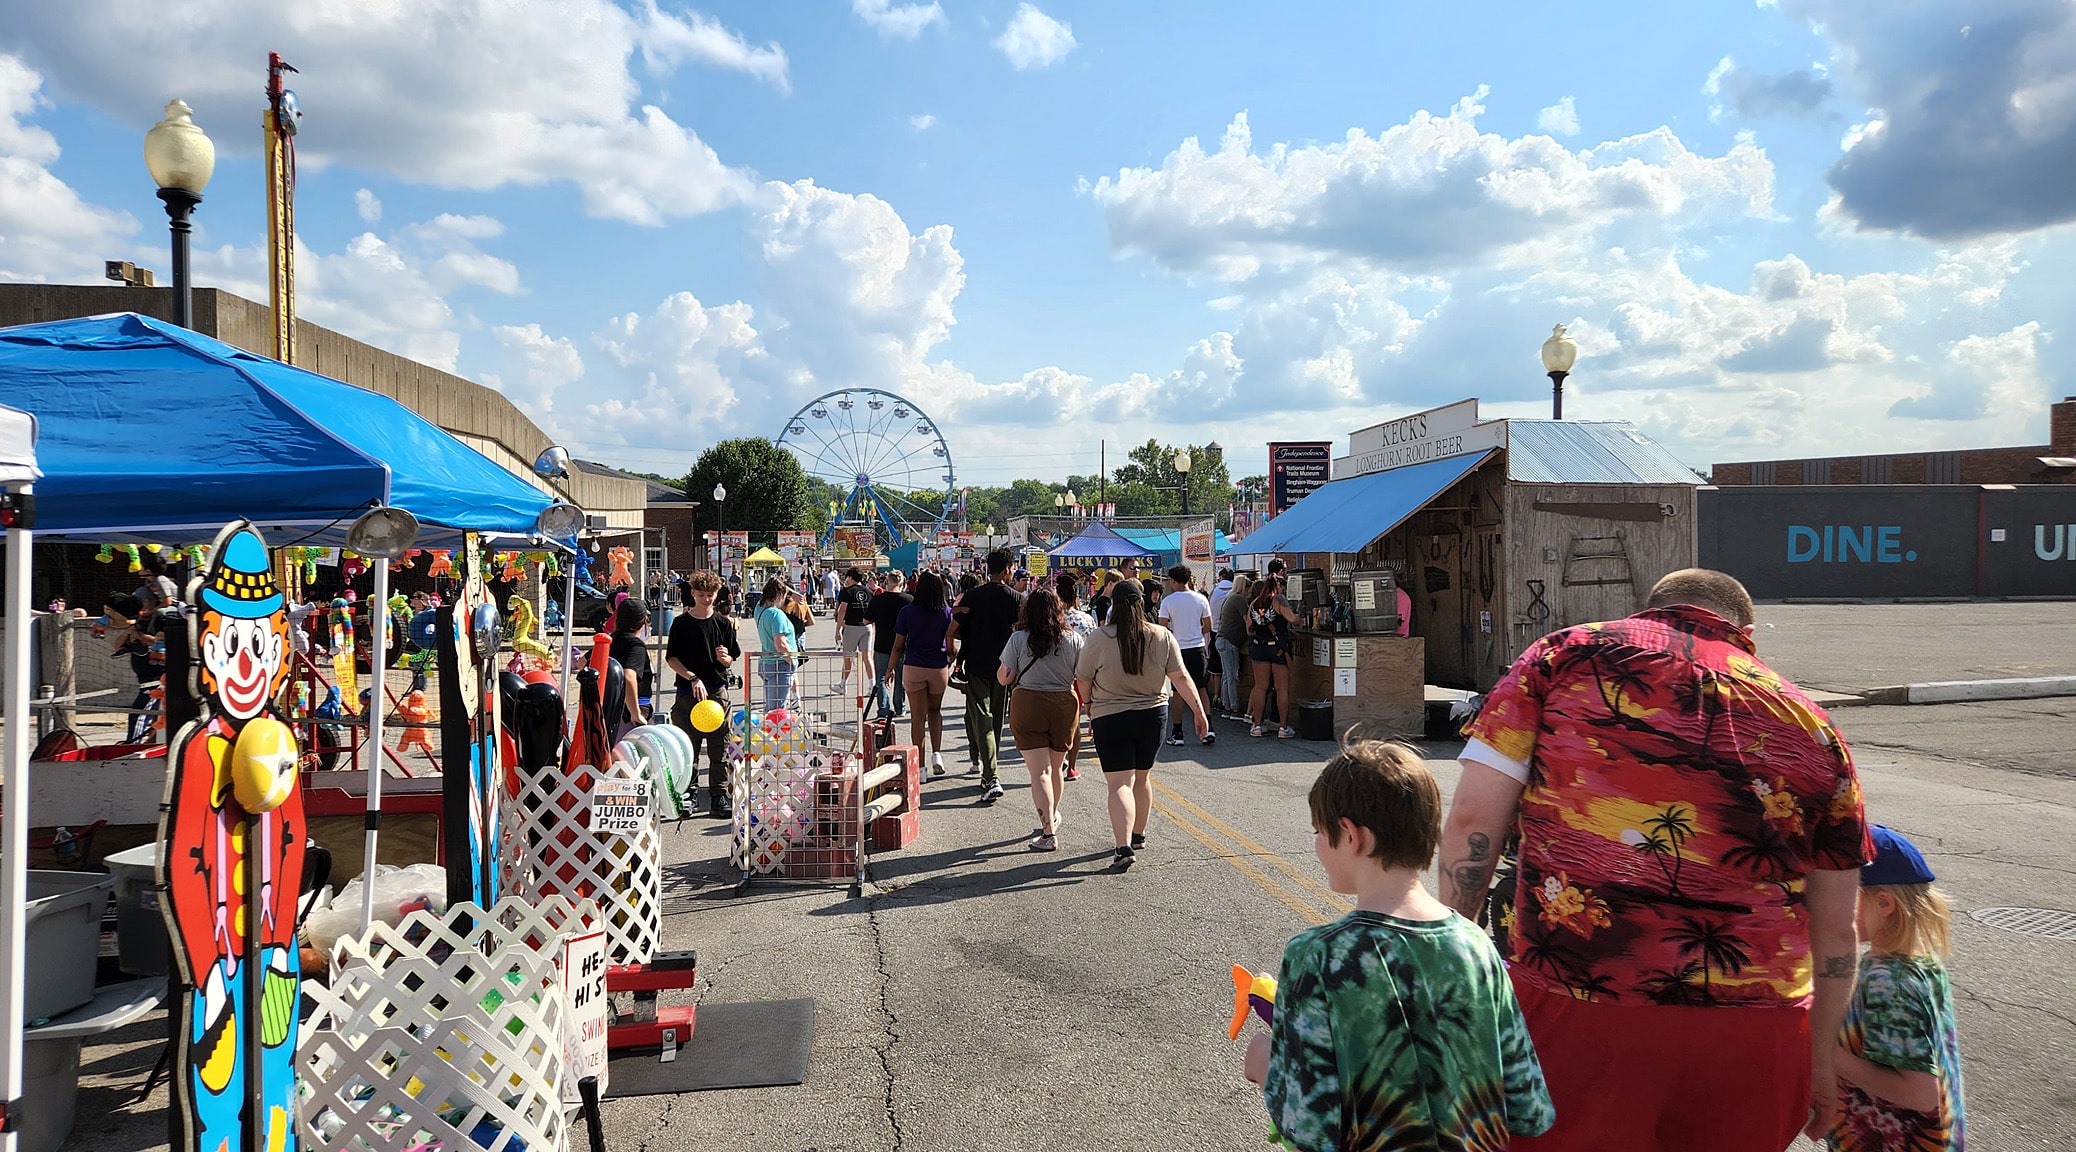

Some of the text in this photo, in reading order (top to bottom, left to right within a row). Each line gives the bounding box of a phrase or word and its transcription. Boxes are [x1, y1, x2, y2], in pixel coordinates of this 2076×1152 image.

[1279, 448, 1325, 459] Independence
[1356, 435, 1463, 473] LONGHORN ROOT BEER
[1787, 525, 1918, 563] DINE.
[2034, 524, 2076, 561] U
[1060, 556, 1103, 567] LUCKY
[633, 783, 646, 796] $8
[605, 796, 638, 806] & WIN
[594, 806, 645, 818] JUMBO
[598, 818, 639, 829] Prize
